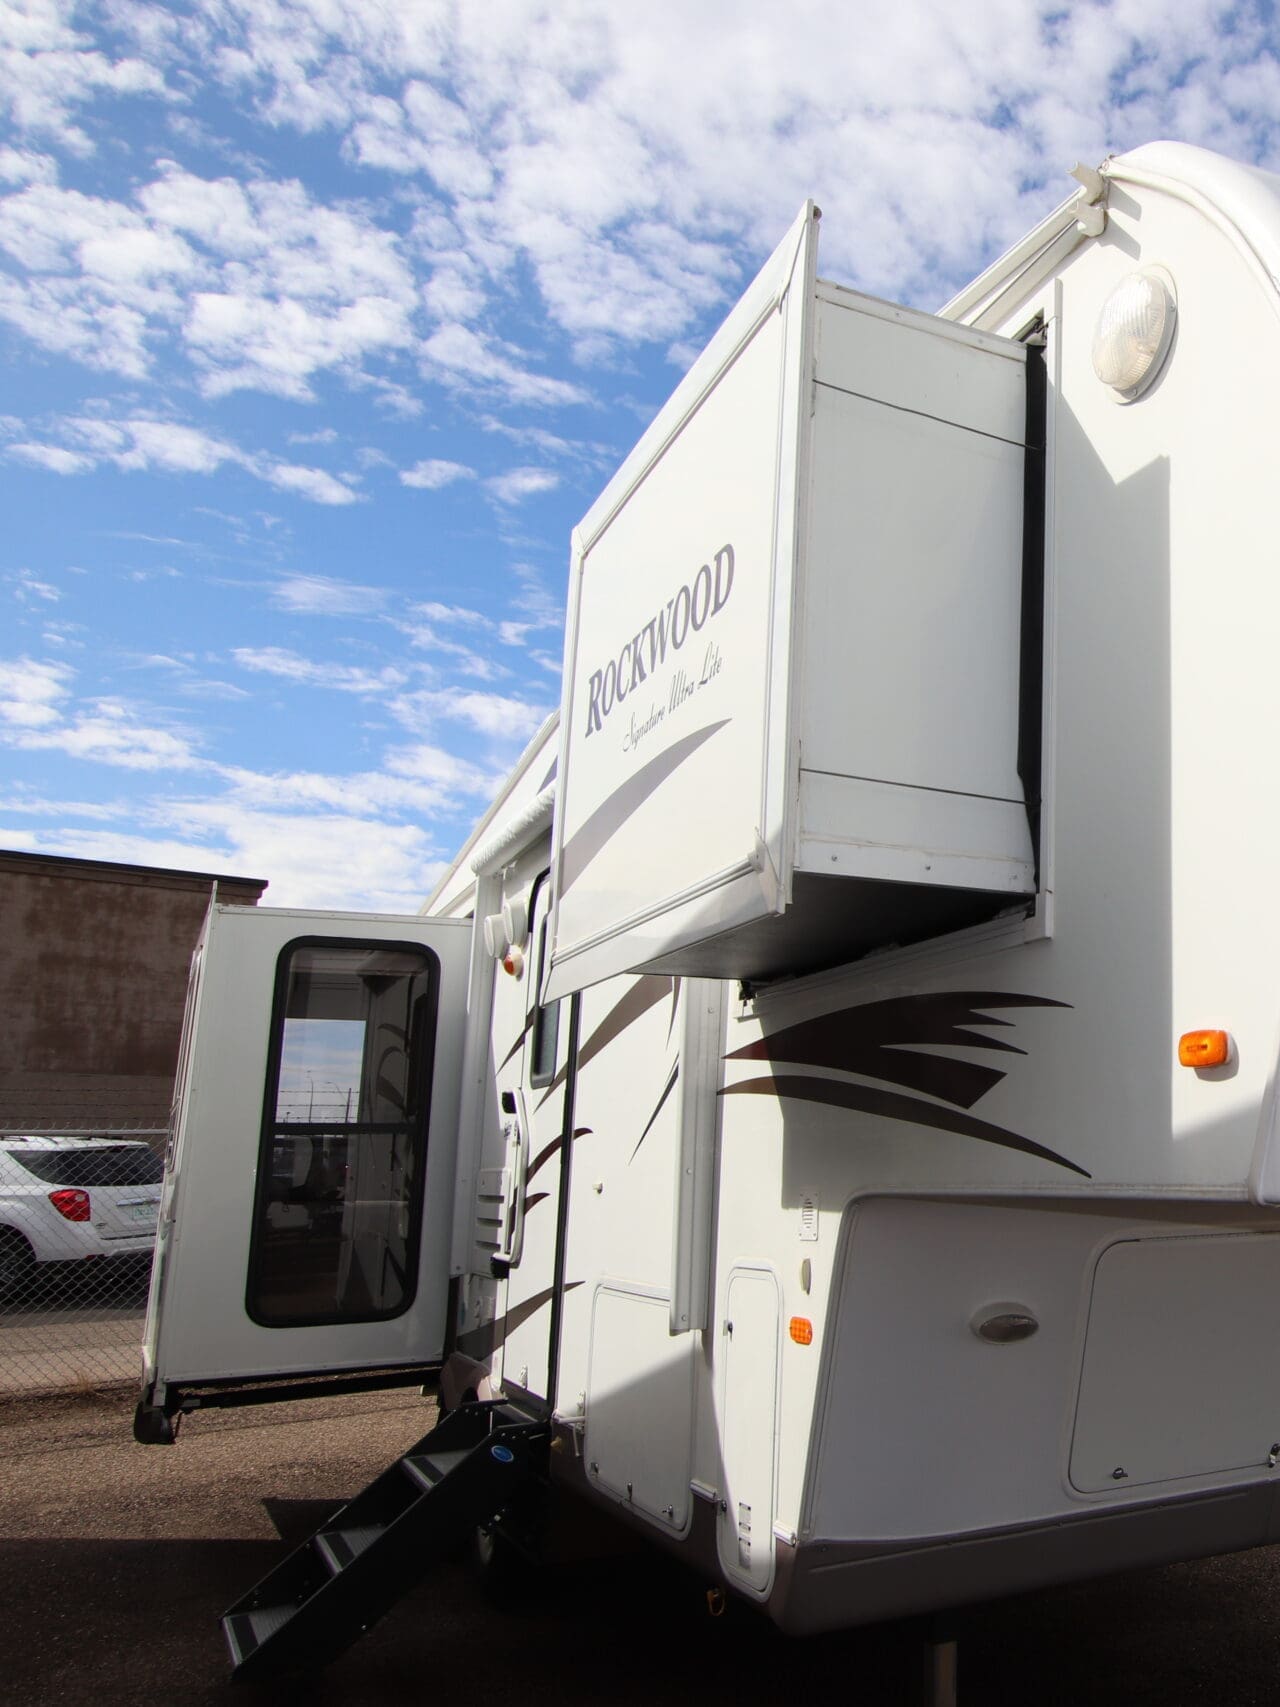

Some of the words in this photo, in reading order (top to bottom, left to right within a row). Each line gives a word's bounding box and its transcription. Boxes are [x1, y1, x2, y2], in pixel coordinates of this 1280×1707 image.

[585, 543, 735, 738] ROCKWOOD
[622, 702, 665, 752] Signature
[668, 669, 694, 714] Ultra
[697, 641, 722, 690] Lite
